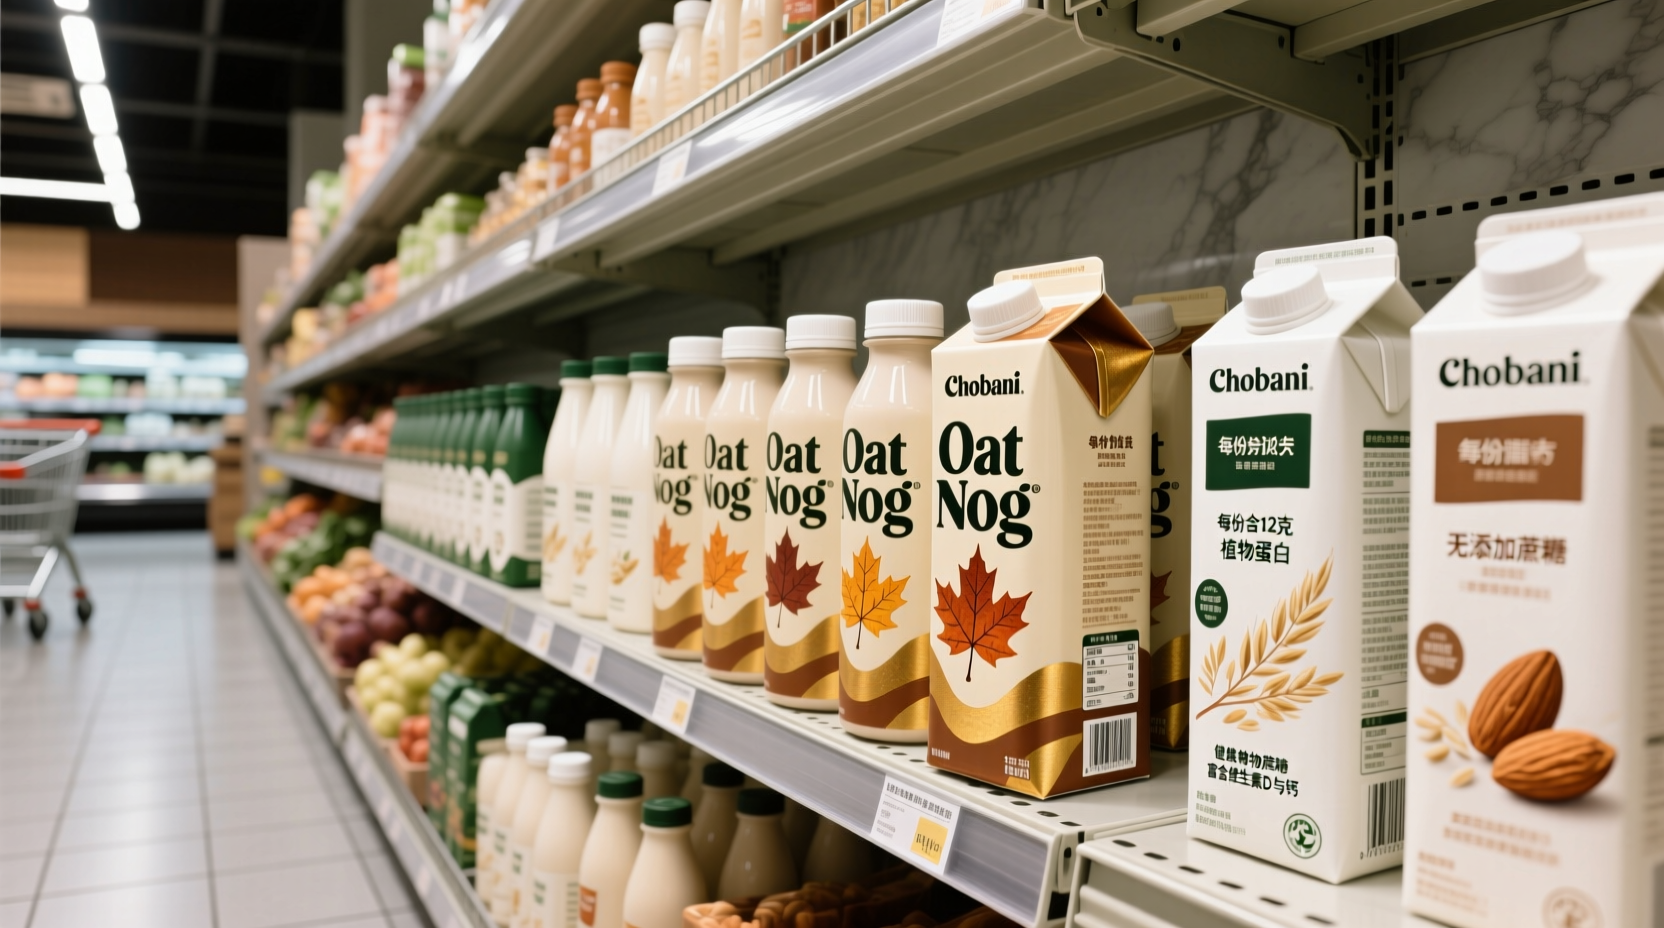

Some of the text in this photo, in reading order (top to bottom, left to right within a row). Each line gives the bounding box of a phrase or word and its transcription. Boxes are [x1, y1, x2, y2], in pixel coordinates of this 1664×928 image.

[945, 371, 1024, 397] Chobani
[1209, 363, 1309, 393] Chobani
[1440, 351, 1580, 388] Chobani
[705, 434, 749, 471] Oat
[766, 432, 821, 474] Oat
[843, 428, 907, 476] Oat
[939, 421, 1024, 476] Oat
[1220, 538, 1290, 565] 植物蛋白
[1447, 532, 1567, 565] 无添加蔗糖
